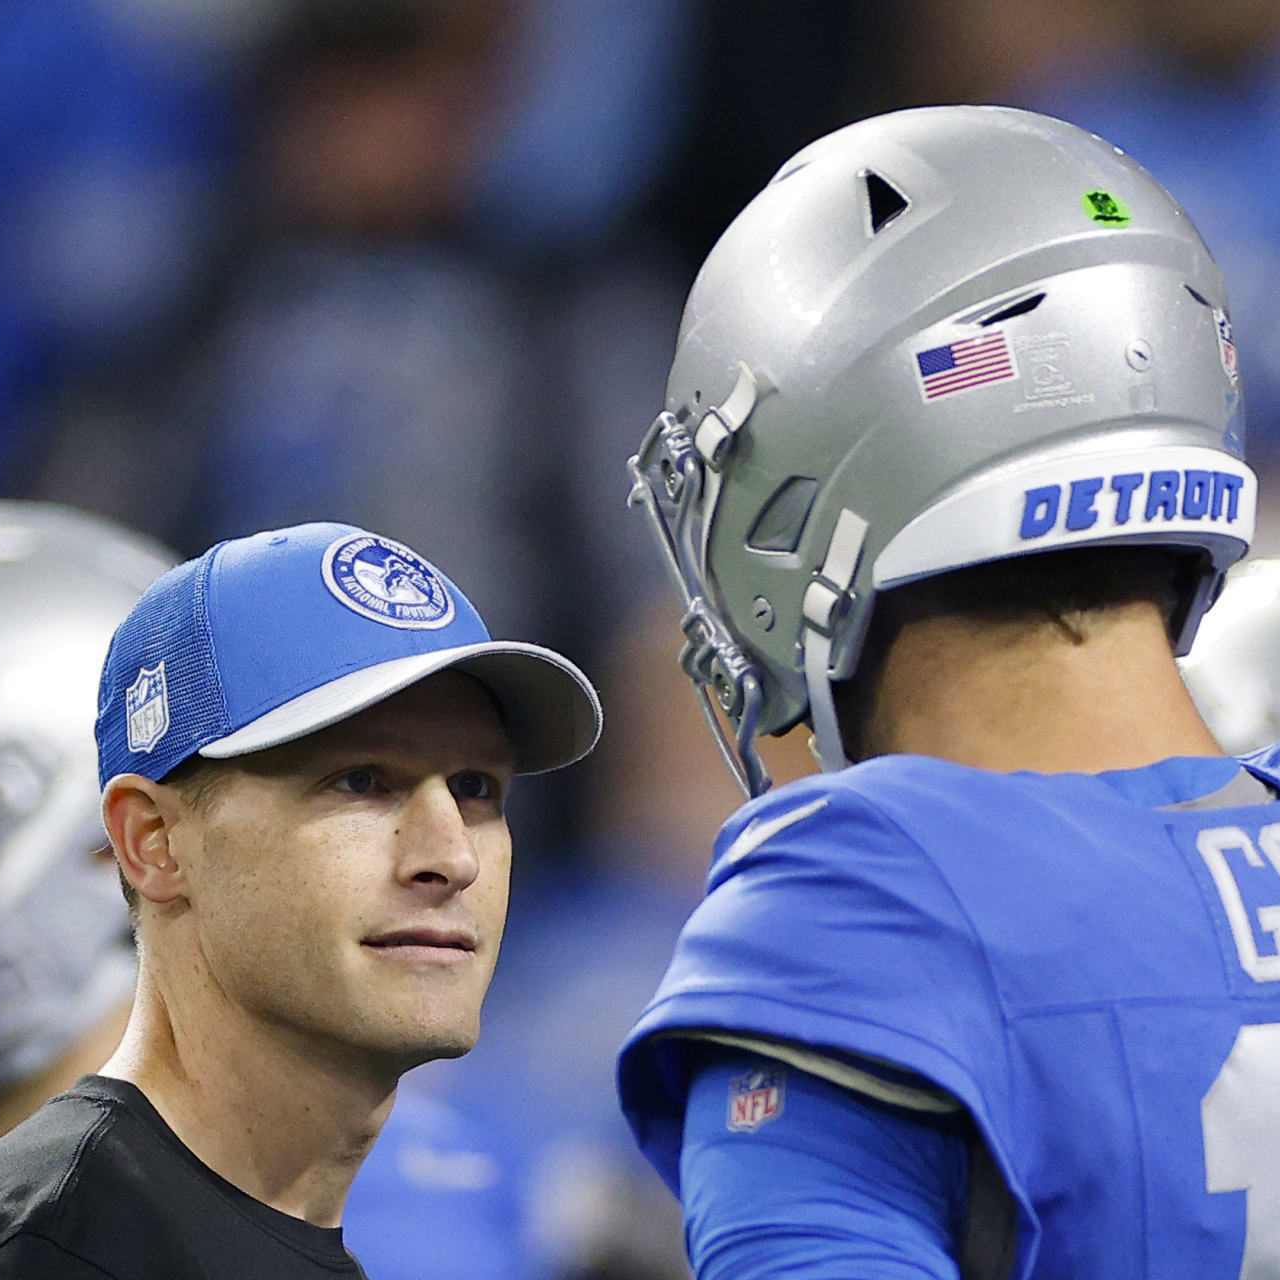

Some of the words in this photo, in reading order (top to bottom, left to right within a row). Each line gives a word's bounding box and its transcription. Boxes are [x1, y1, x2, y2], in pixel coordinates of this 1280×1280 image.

[1019, 470, 1244, 540] DETROIT
[132, 703, 162, 742] NFL
[735, 1089, 776, 1122] NFL
